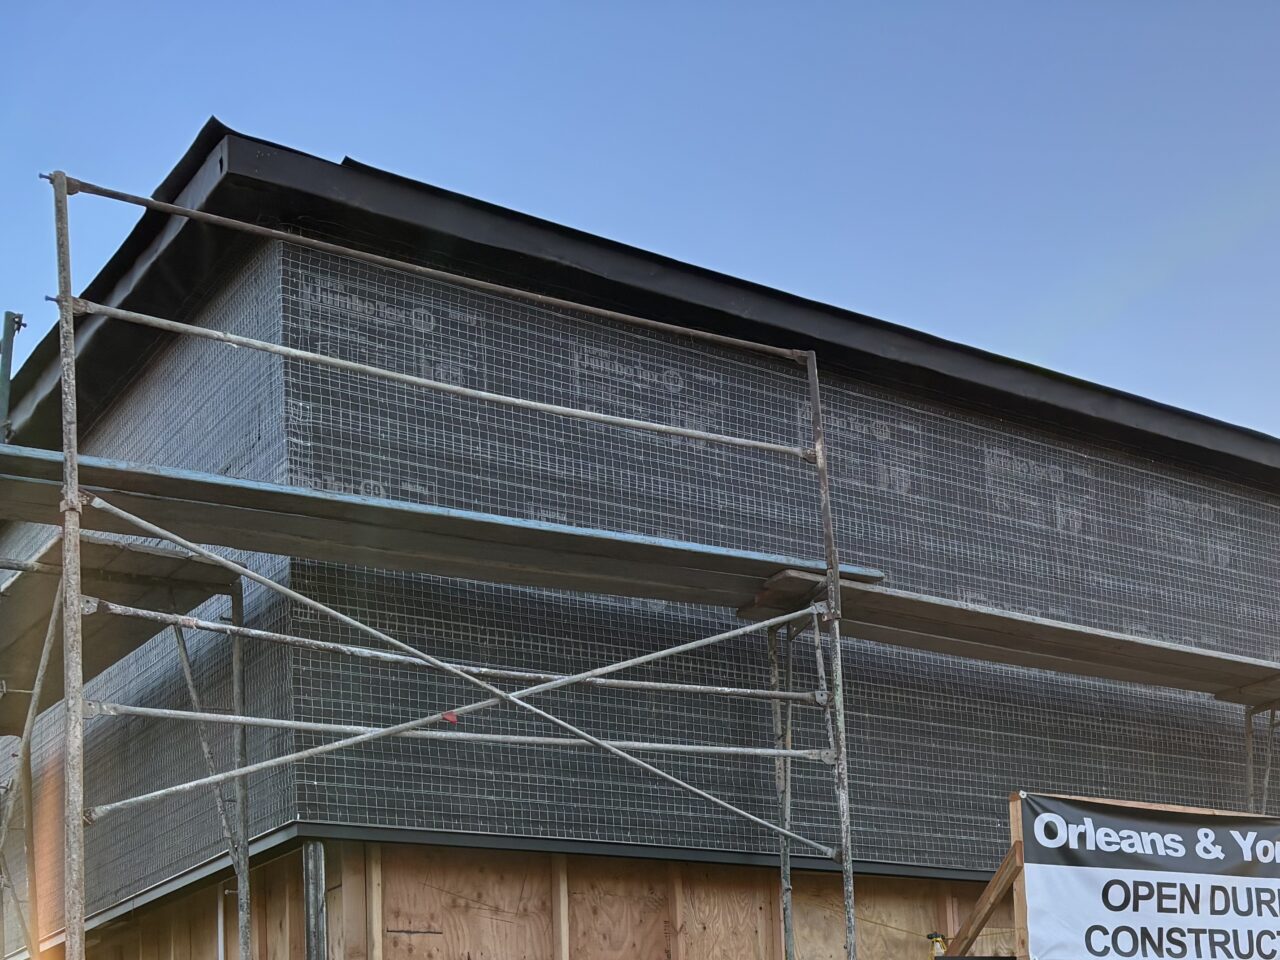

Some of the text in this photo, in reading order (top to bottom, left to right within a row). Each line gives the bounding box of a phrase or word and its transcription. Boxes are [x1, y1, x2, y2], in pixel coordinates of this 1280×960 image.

[1033, 813, 1186, 857] Orleans
[1195, 828, 1225, 860] &
[1101, 879, 1200, 915] OPEN
